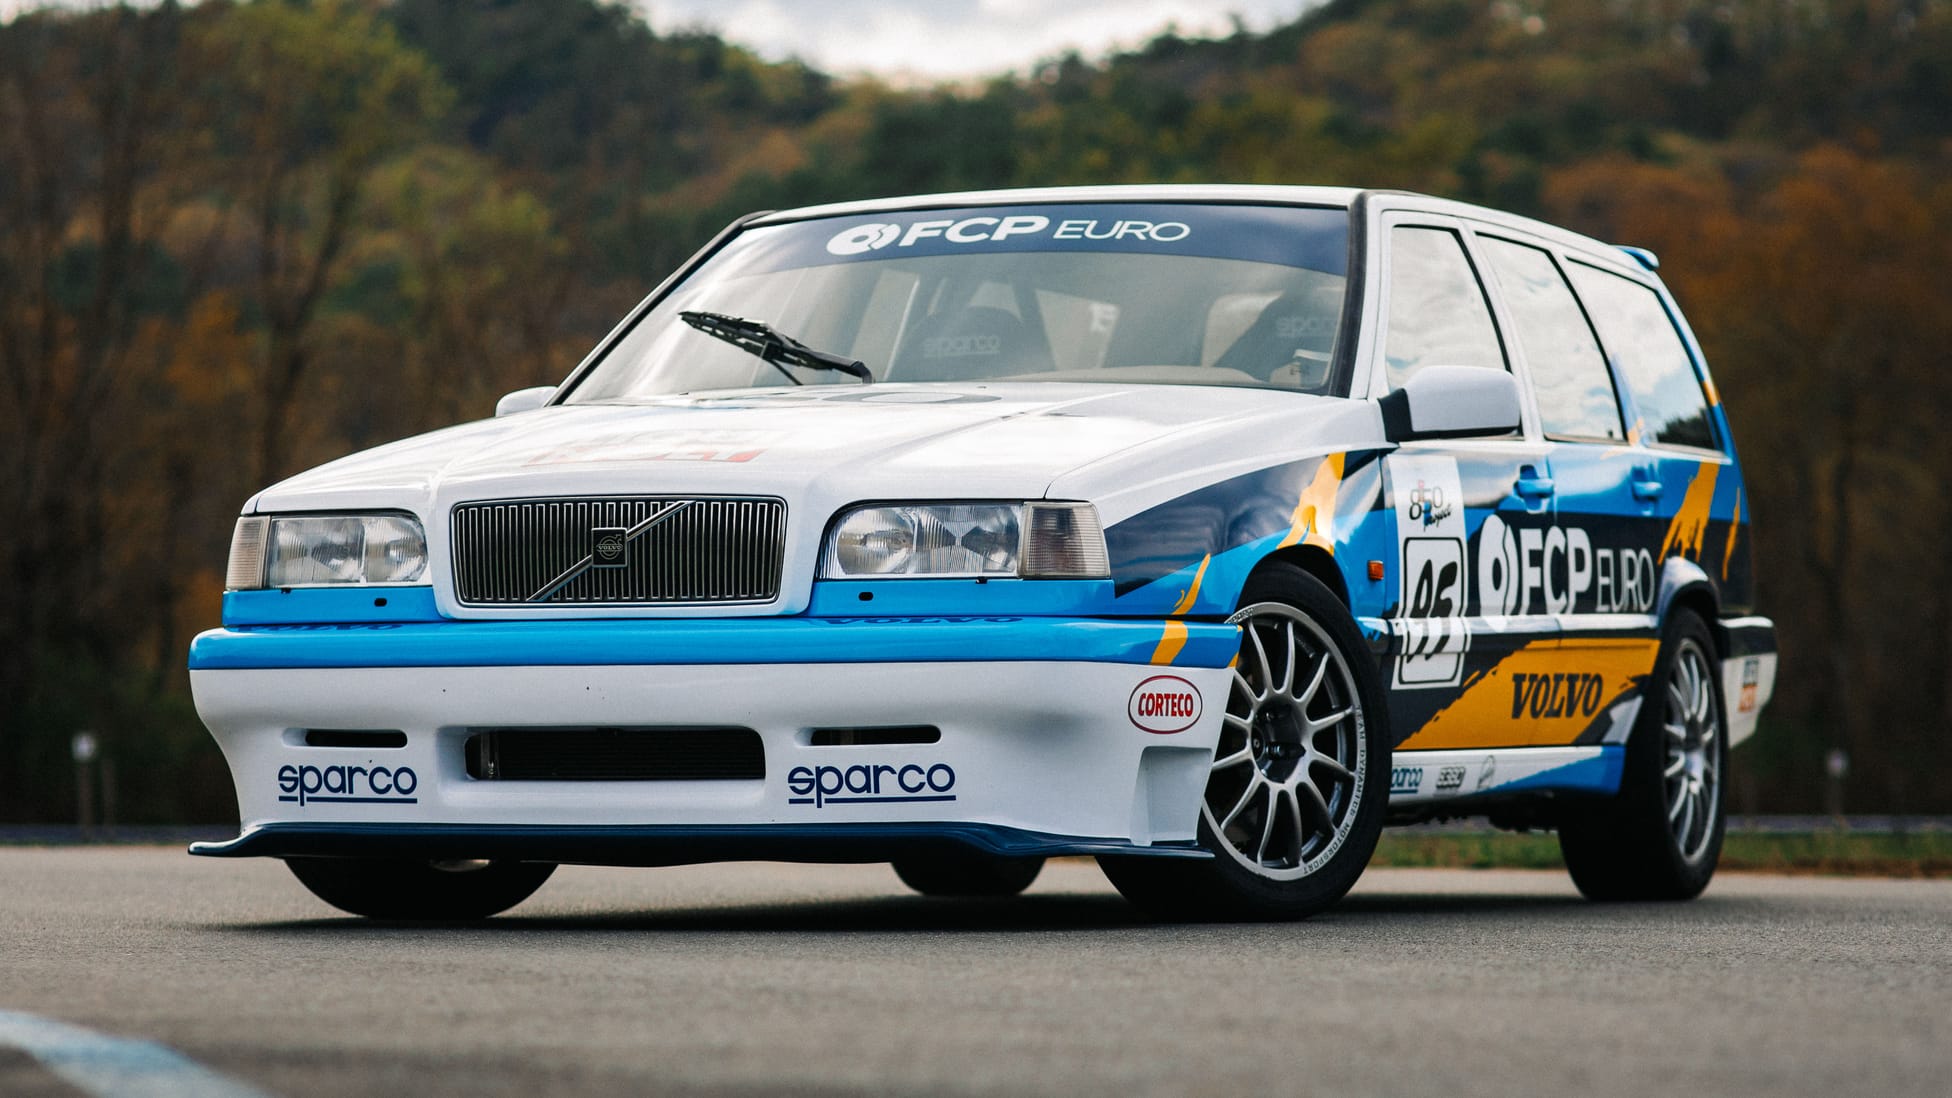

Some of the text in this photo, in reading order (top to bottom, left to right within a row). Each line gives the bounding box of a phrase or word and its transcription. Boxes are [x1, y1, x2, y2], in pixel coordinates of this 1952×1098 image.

[899, 215, 1191, 248] FCP EURO
[1519, 525, 1655, 616] FCP EURO
[1137, 692, 1194, 718] CORTECO
[1511, 673, 1604, 720] VOLVO
[278, 764, 417, 806] sparco
[788, 763, 957, 808] sparco
[1303, 822, 1350, 875] MOTORSPORT
